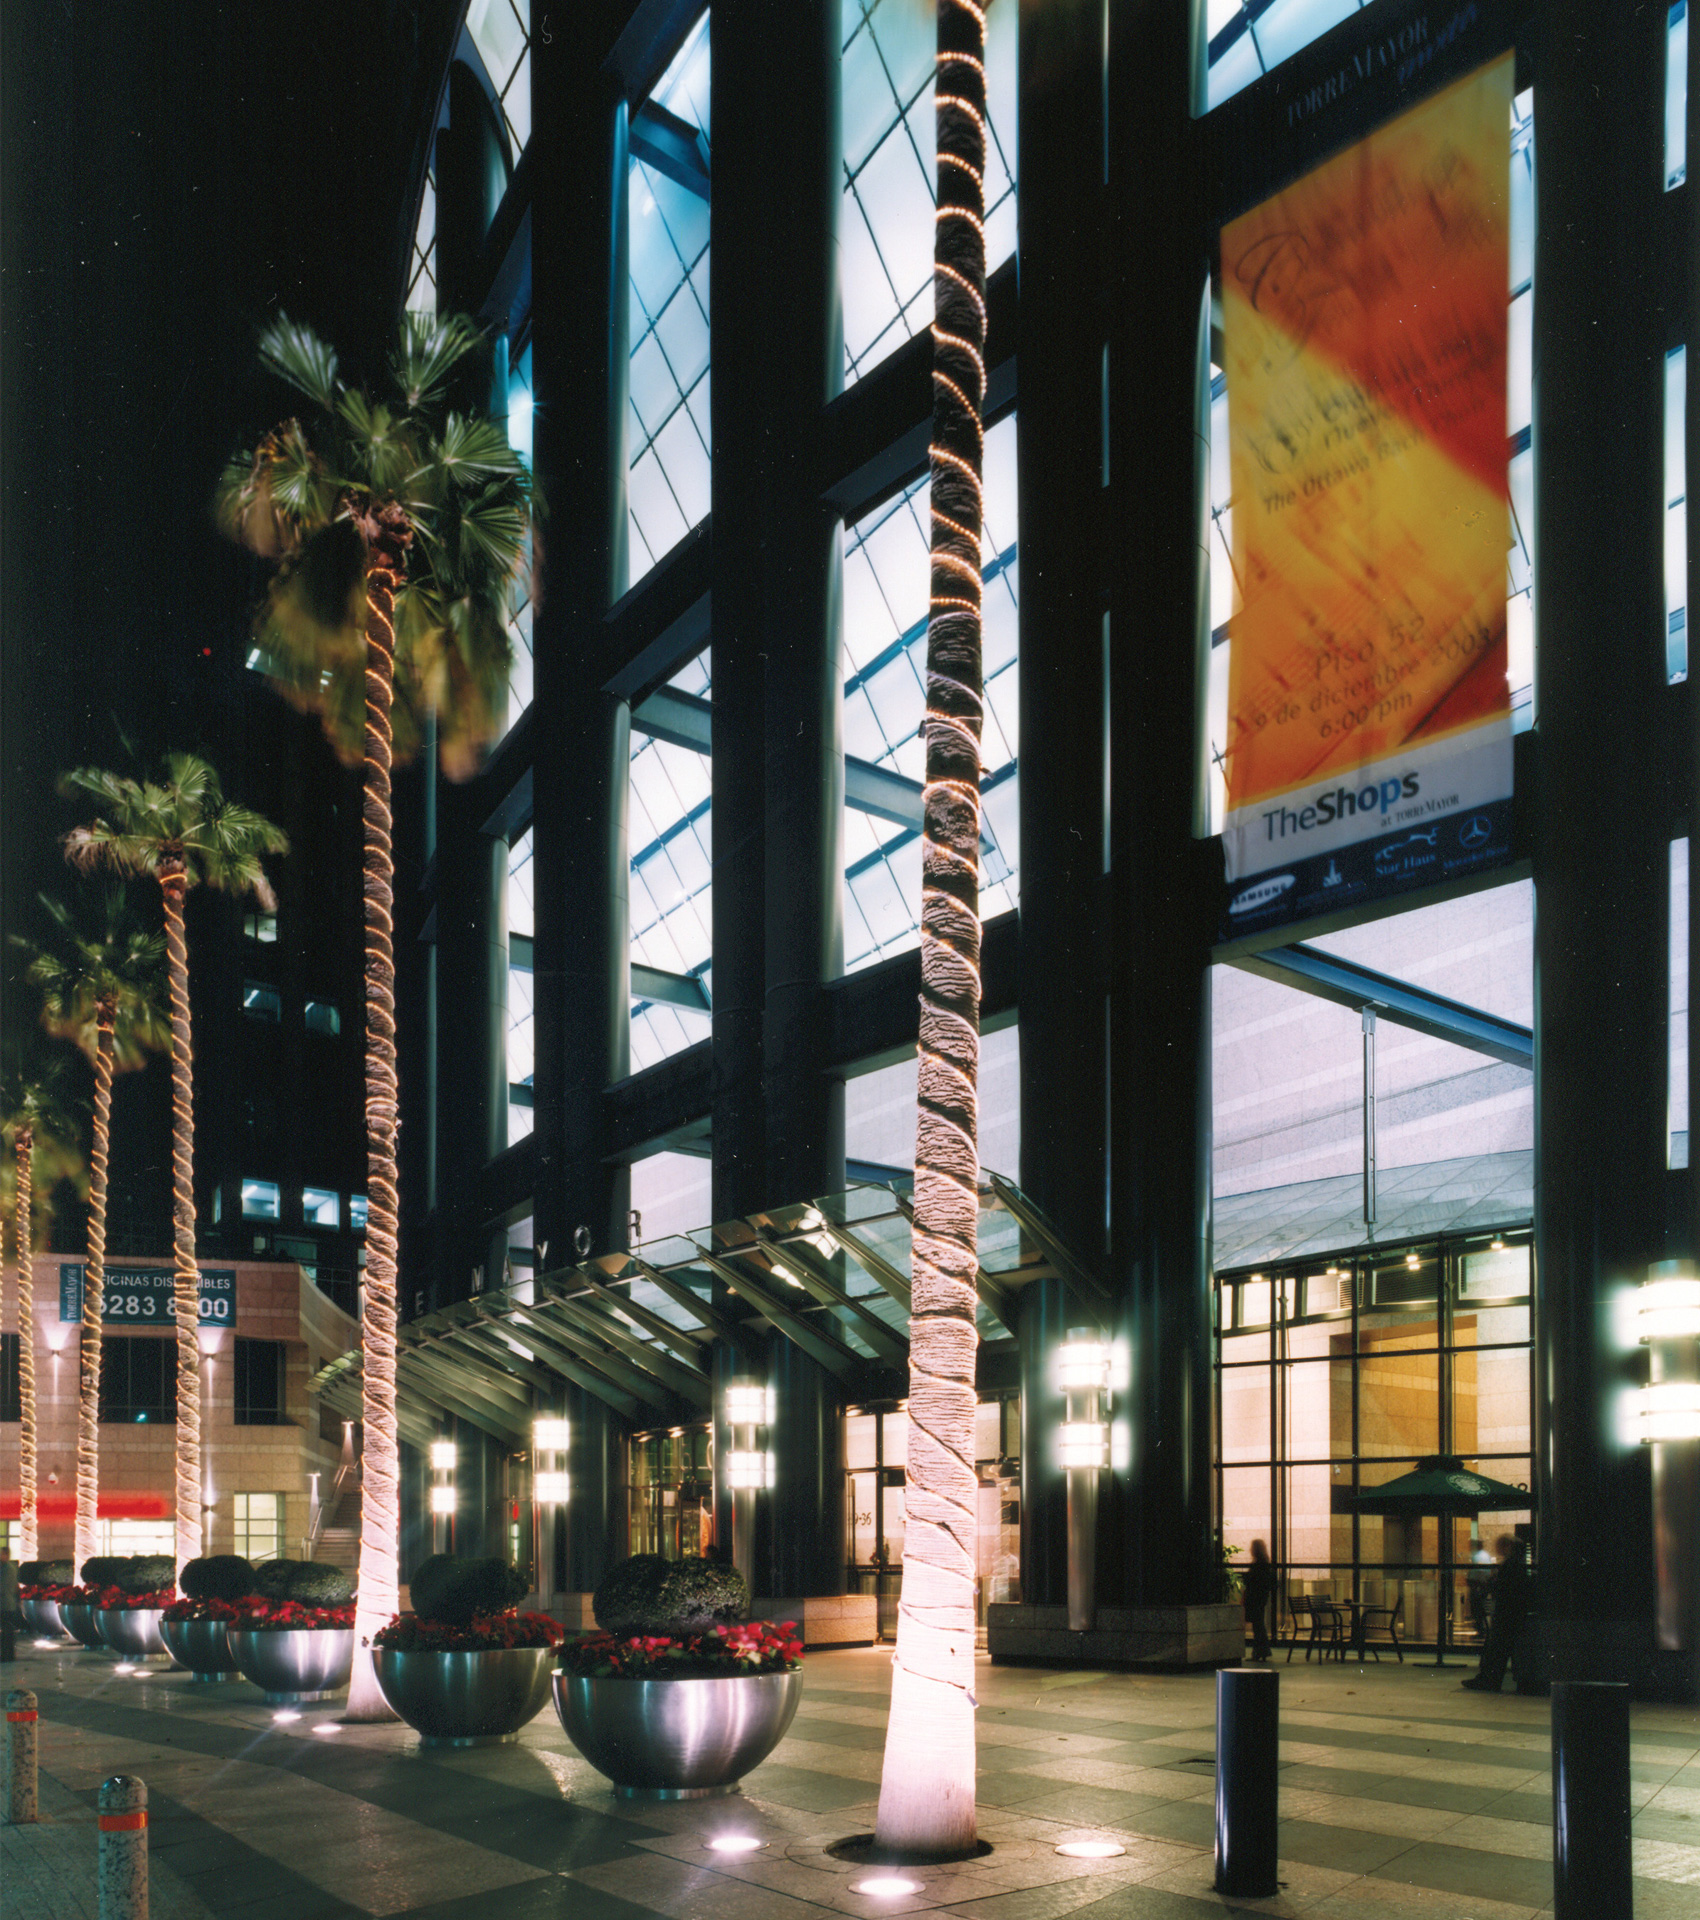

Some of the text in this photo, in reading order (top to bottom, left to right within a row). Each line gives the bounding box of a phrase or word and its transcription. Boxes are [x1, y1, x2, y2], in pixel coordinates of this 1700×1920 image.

[1315, 614, 1425, 680] Piso 52
[1276, 702, 1302, 726] de
[1309, 658, 1421, 713] diciembre
[1320, 691, 1414, 738] 6:00 pm
[1380, 815, 1393, 828] at
[1233, 882, 1288, 904] SAMSUNG
[101, 1274, 231, 1289] FICINAS DISIBLES
[166, 1297, 229, 1318] 800
